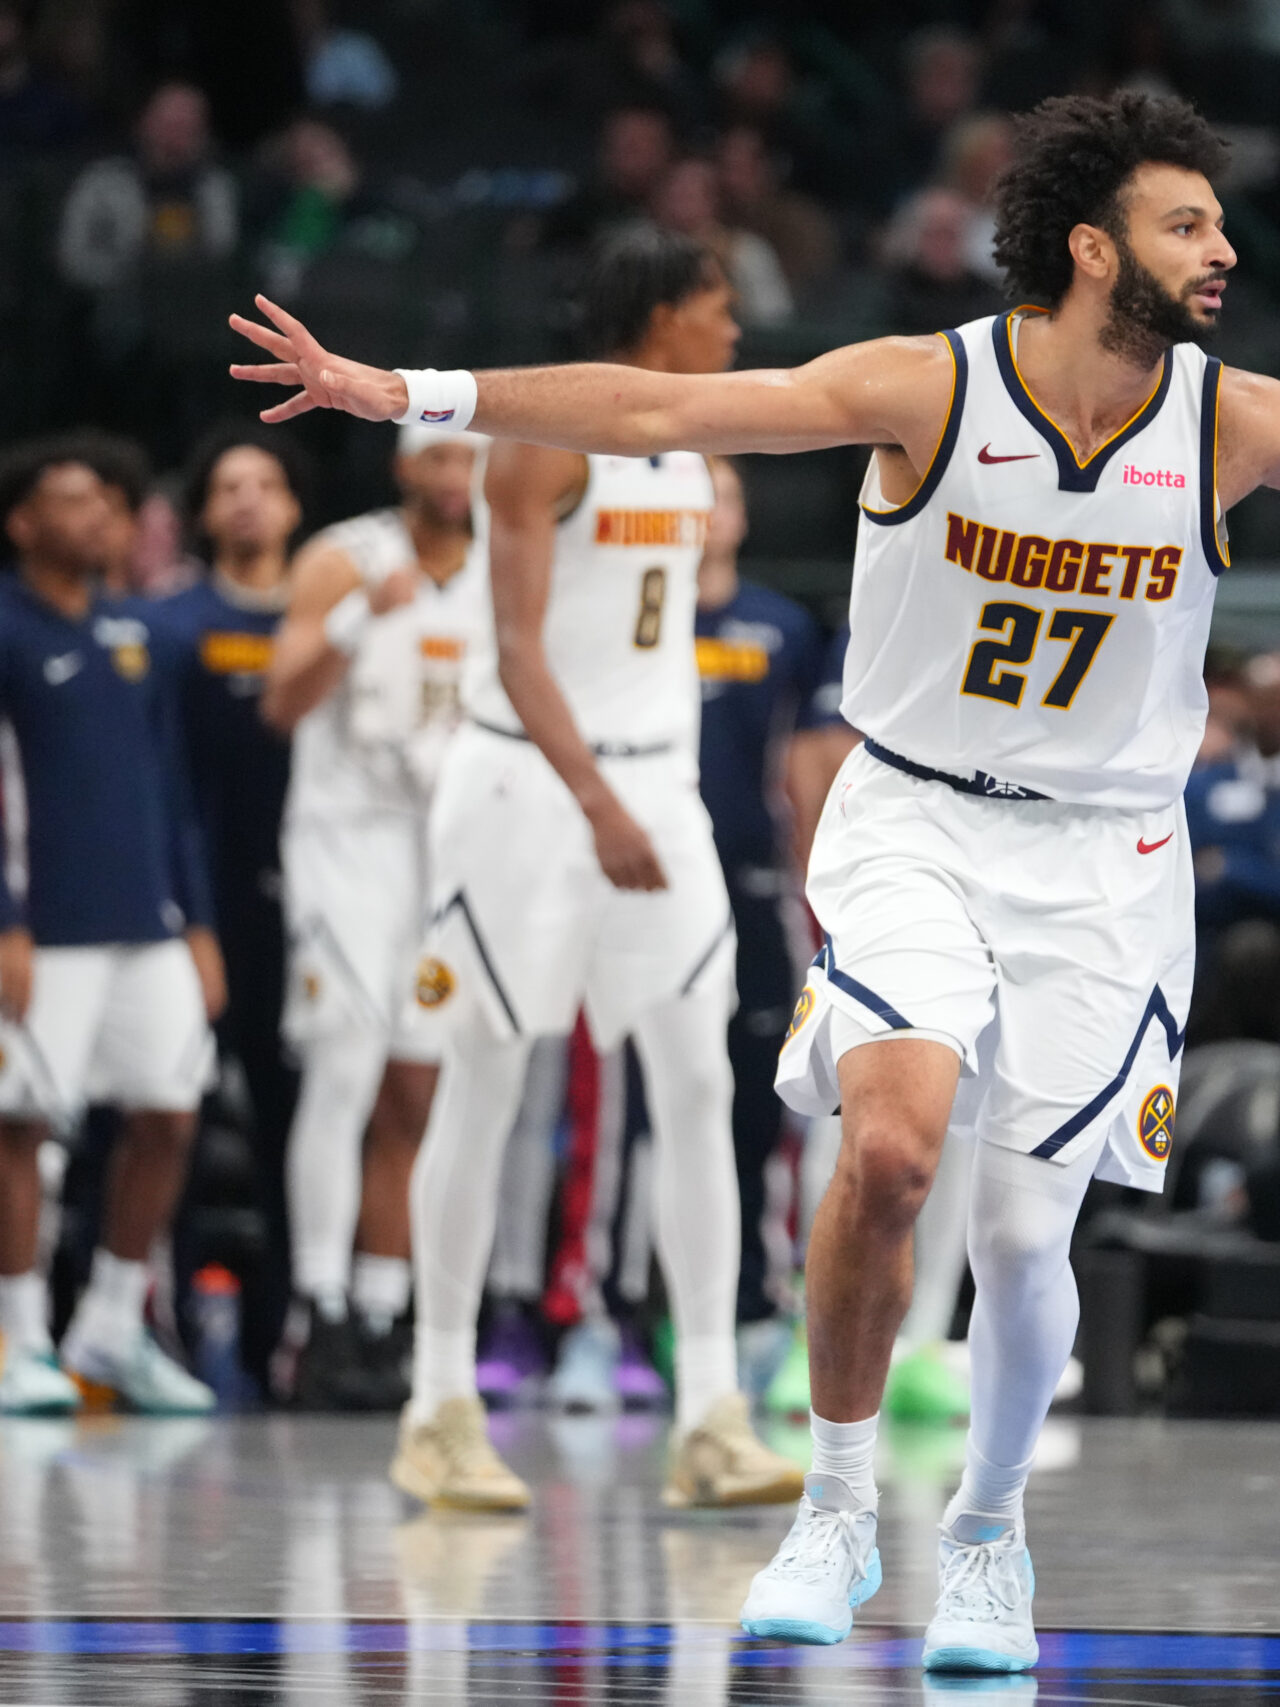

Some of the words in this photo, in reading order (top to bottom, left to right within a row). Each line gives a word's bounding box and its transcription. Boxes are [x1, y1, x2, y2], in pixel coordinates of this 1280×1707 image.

[1122, 464, 1186, 489] ibotta
[945, 511, 1184, 602] NUGGETS
[634, 567, 665, 647] 8
[960, 599, 1118, 711] 27
